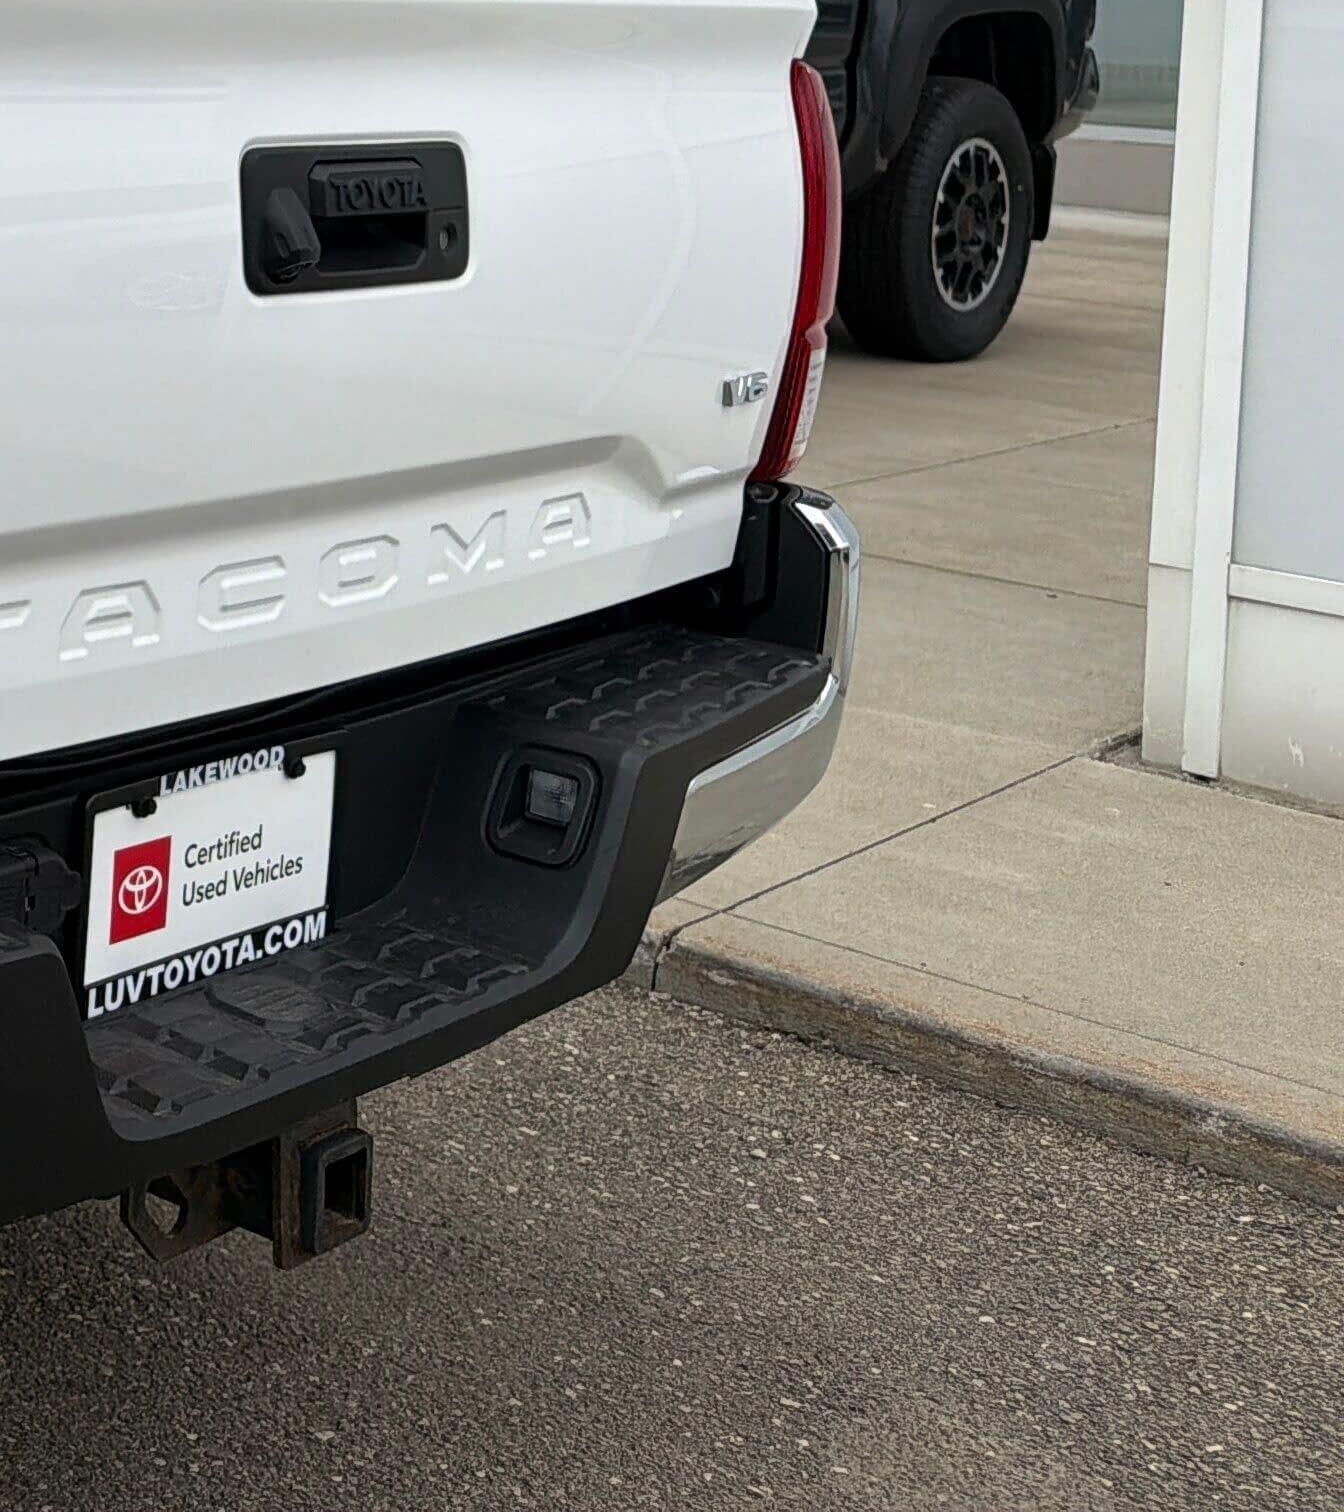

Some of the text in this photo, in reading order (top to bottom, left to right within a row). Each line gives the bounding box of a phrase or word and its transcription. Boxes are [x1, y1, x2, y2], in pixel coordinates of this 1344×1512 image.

[329, 176, 427, 213] TOYOTA
[721, 371, 768, 407] V6
[159, 745, 285, 797] LAKEWOOD
[184, 824, 262, 868] Certified
[182, 854, 303, 907] Used Vehicles
[87, 910, 327, 1020] LUVTOYOTA.COM
